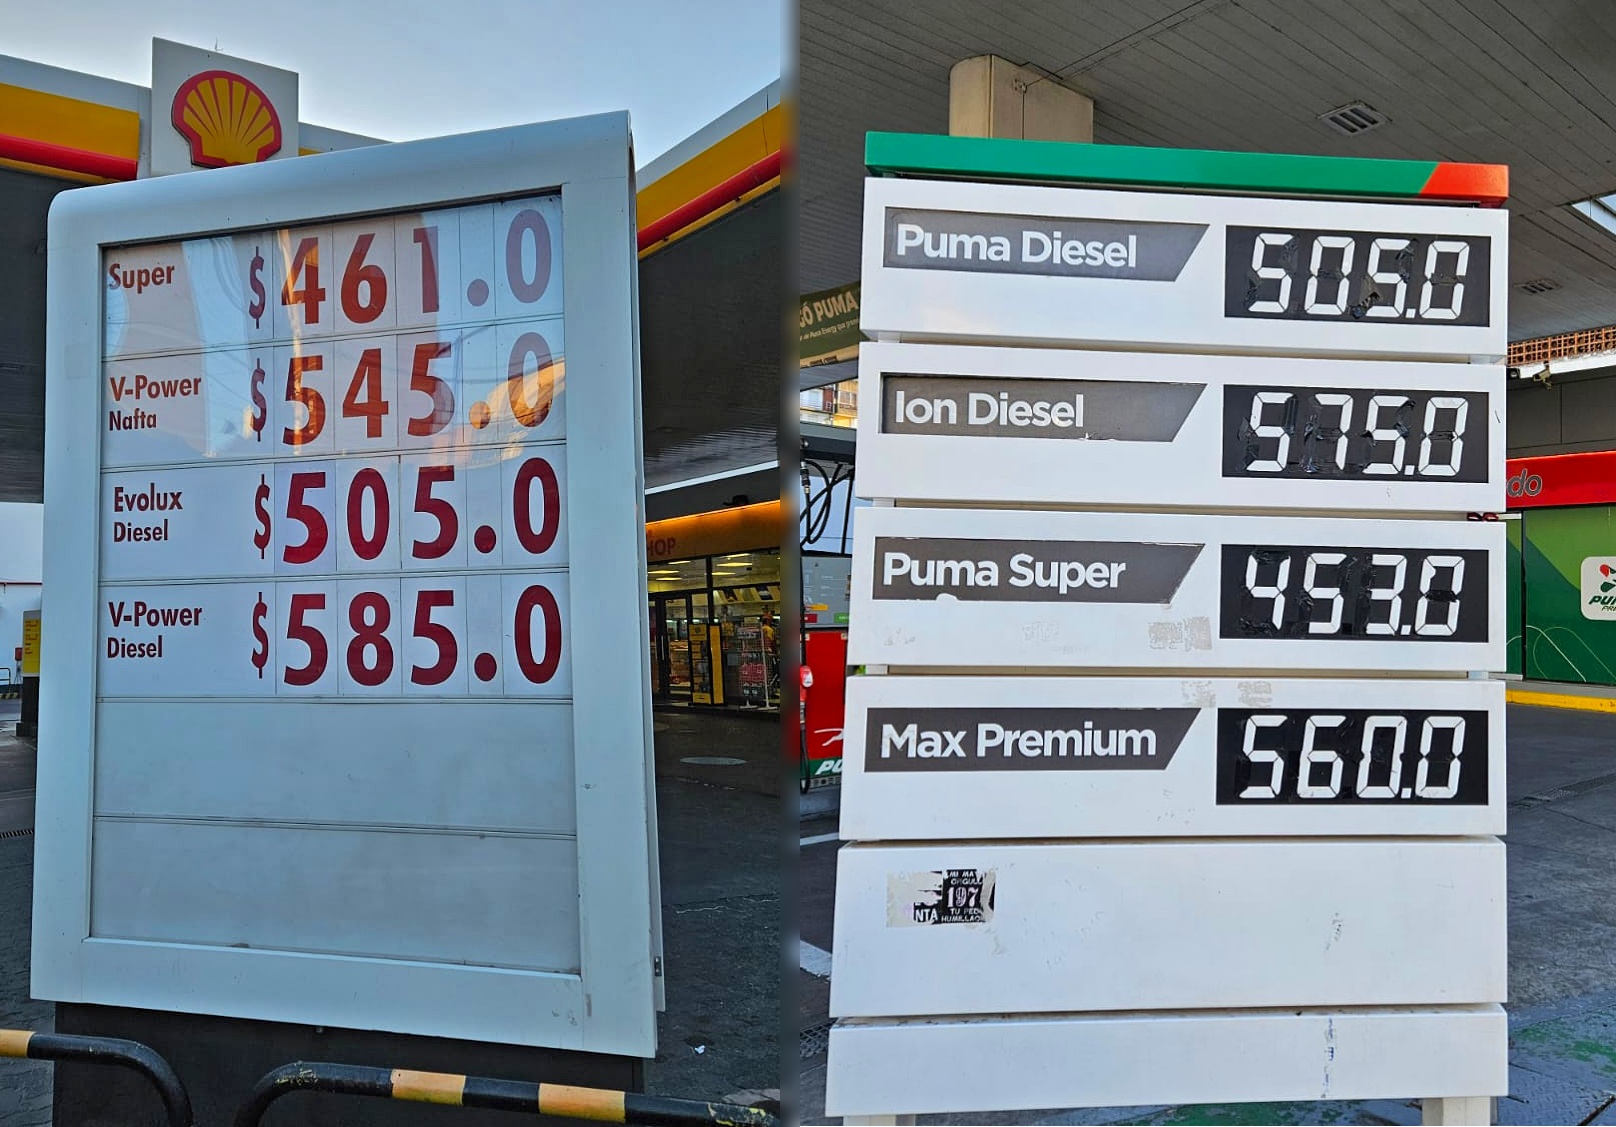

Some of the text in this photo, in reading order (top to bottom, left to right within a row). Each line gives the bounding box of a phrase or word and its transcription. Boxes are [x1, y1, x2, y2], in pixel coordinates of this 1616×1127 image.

[108, 263, 175, 294] Super
[897, 224, 1471, 321] Puma Diesel 505.0
[813, 291, 859, 321] PUMA
[109, 375, 202, 402] V-Power
[108, 409, 157, 431] Nafta
[896, 390, 1470, 477] Ion Diesel 575.0
[113, 483, 183, 512] Evolux
[113, 520, 169, 543] Diesel
[882, 552, 999, 588] Puma
[1009, 553, 1127, 595] Super
[1244, 553, 1466, 637] 453.0
[108, 602, 203, 627] V-Power
[106, 636, 163, 659] Diesel
[881, 715, 1466, 799] Max Premium 560.0
